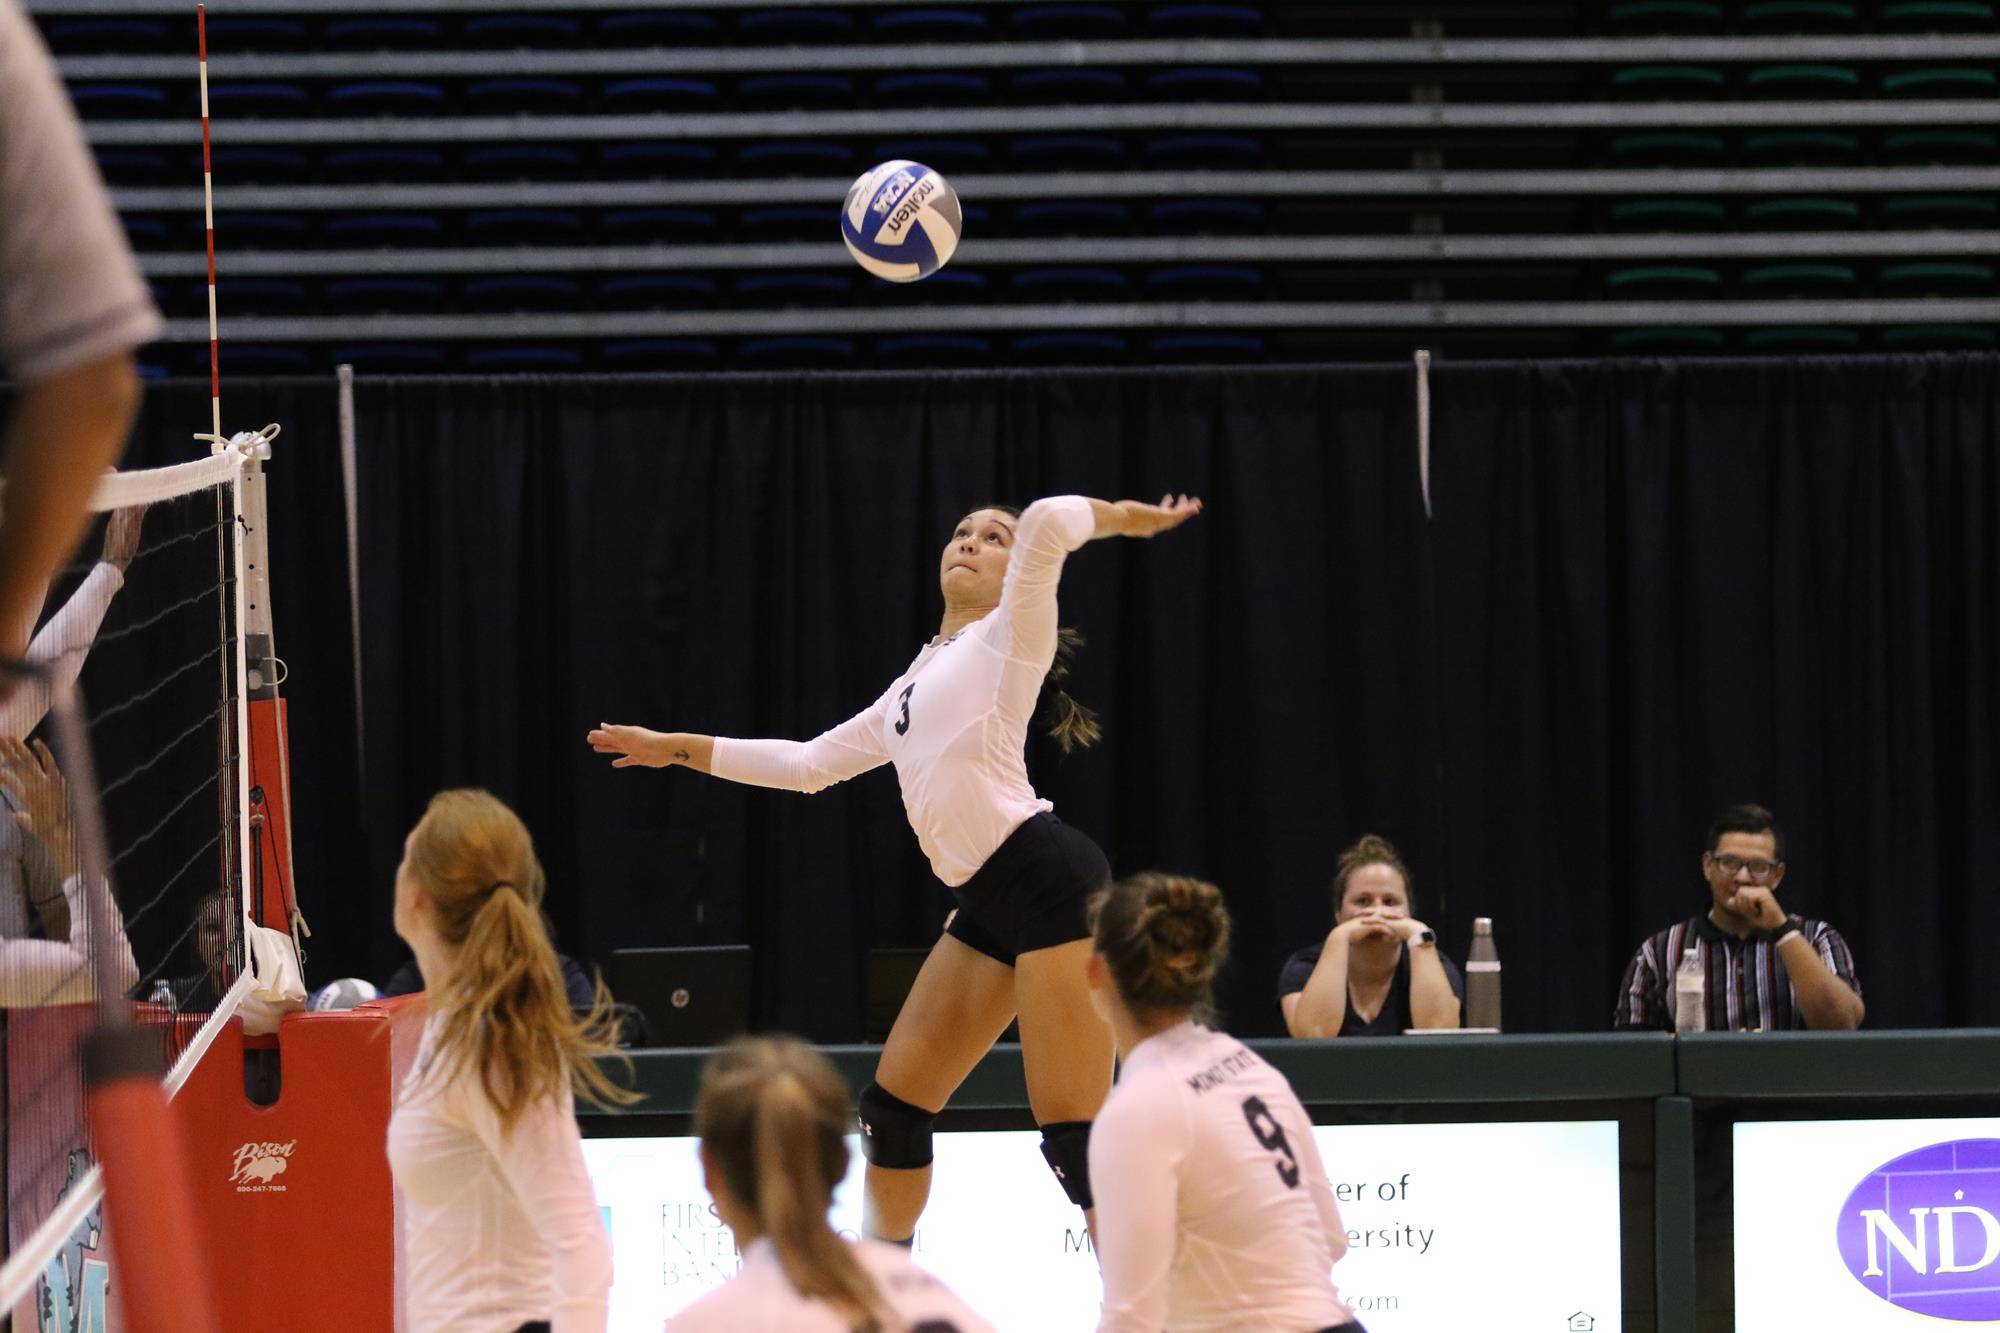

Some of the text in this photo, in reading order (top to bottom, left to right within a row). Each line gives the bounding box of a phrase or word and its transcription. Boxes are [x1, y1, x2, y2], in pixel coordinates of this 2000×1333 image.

[887, 180, 934, 233] molten
[895, 682, 915, 736] 3
[228, 1142, 296, 1181] Bison
[1242, 1096, 1299, 1190] 9
[1378, 1173, 1410, 1201] of
[662, 1202, 726, 1229] FIRS
[663, 1261, 740, 1286] BAN
